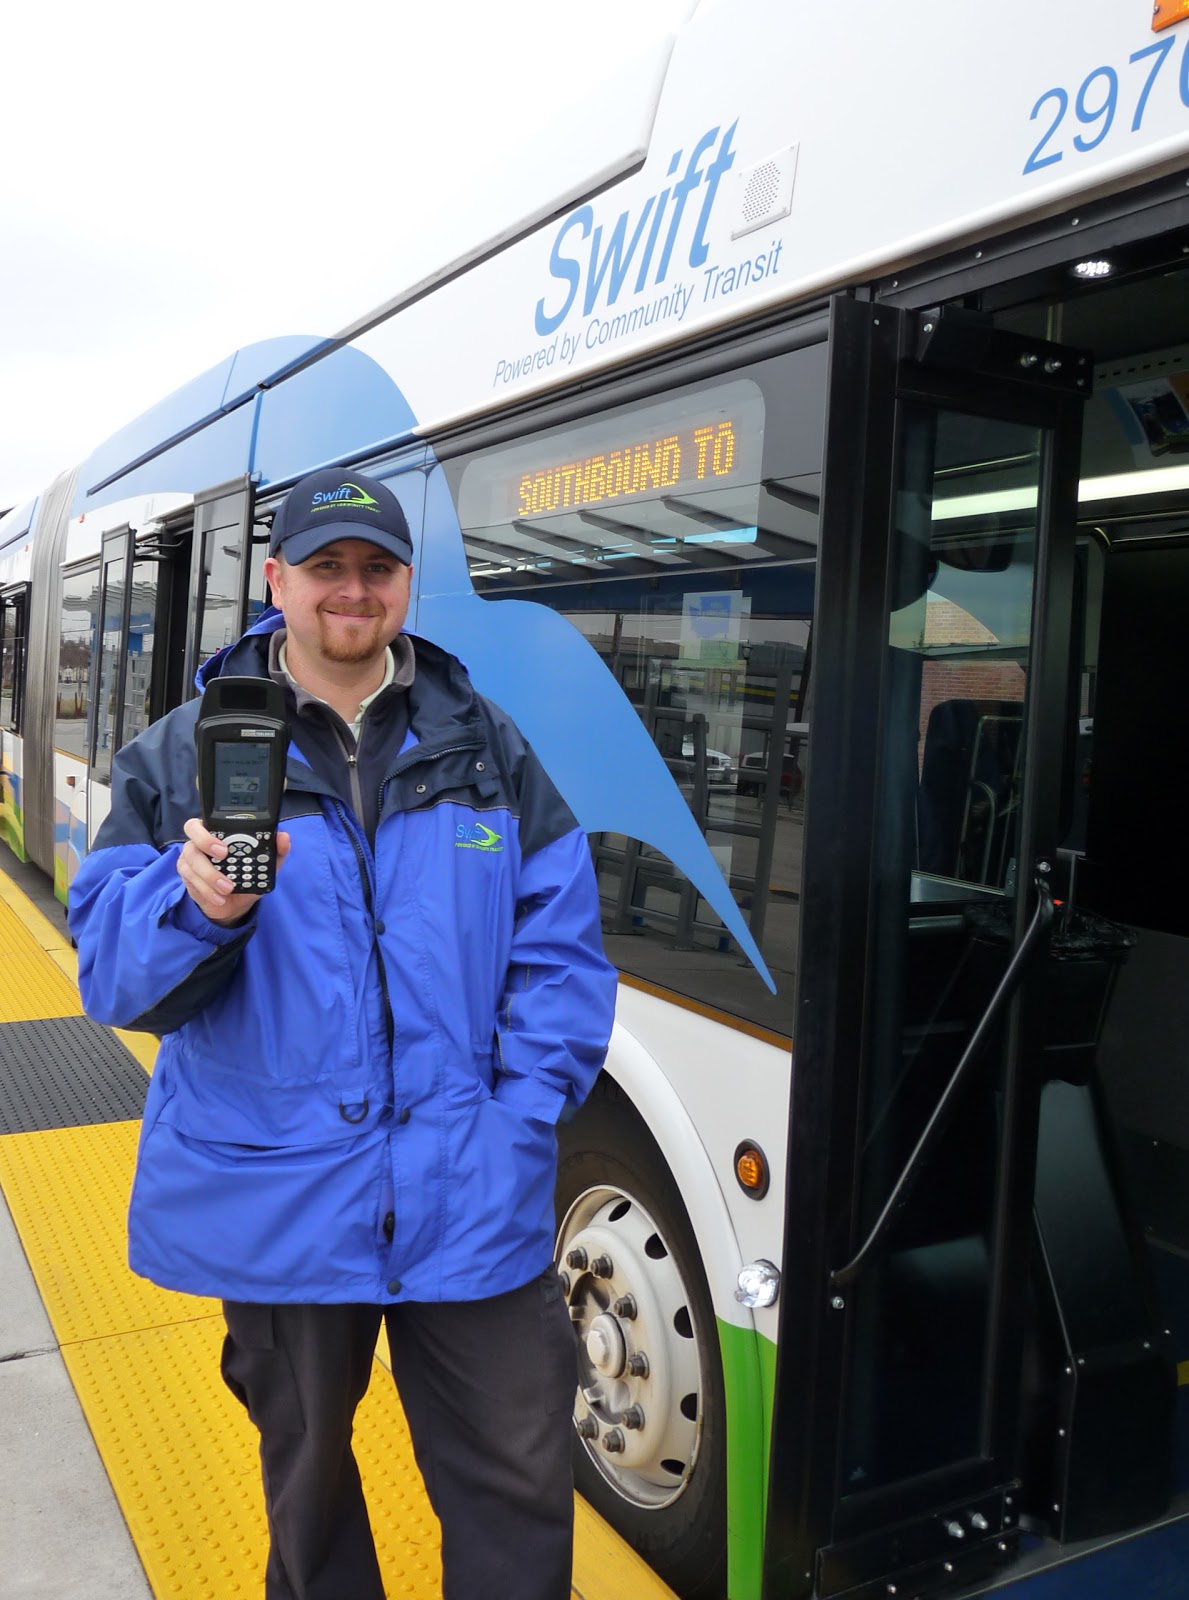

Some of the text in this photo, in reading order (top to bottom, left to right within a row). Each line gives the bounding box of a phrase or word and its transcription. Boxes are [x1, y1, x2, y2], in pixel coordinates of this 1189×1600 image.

[1022, 34, 1189, 176] 297
[535, 117, 739, 336] Swift
[494, 238, 783, 387] Powered by Community Transit
[312, 488, 351, 504] Swift
[518, 421, 735, 515] SOUTHBOUND TO
